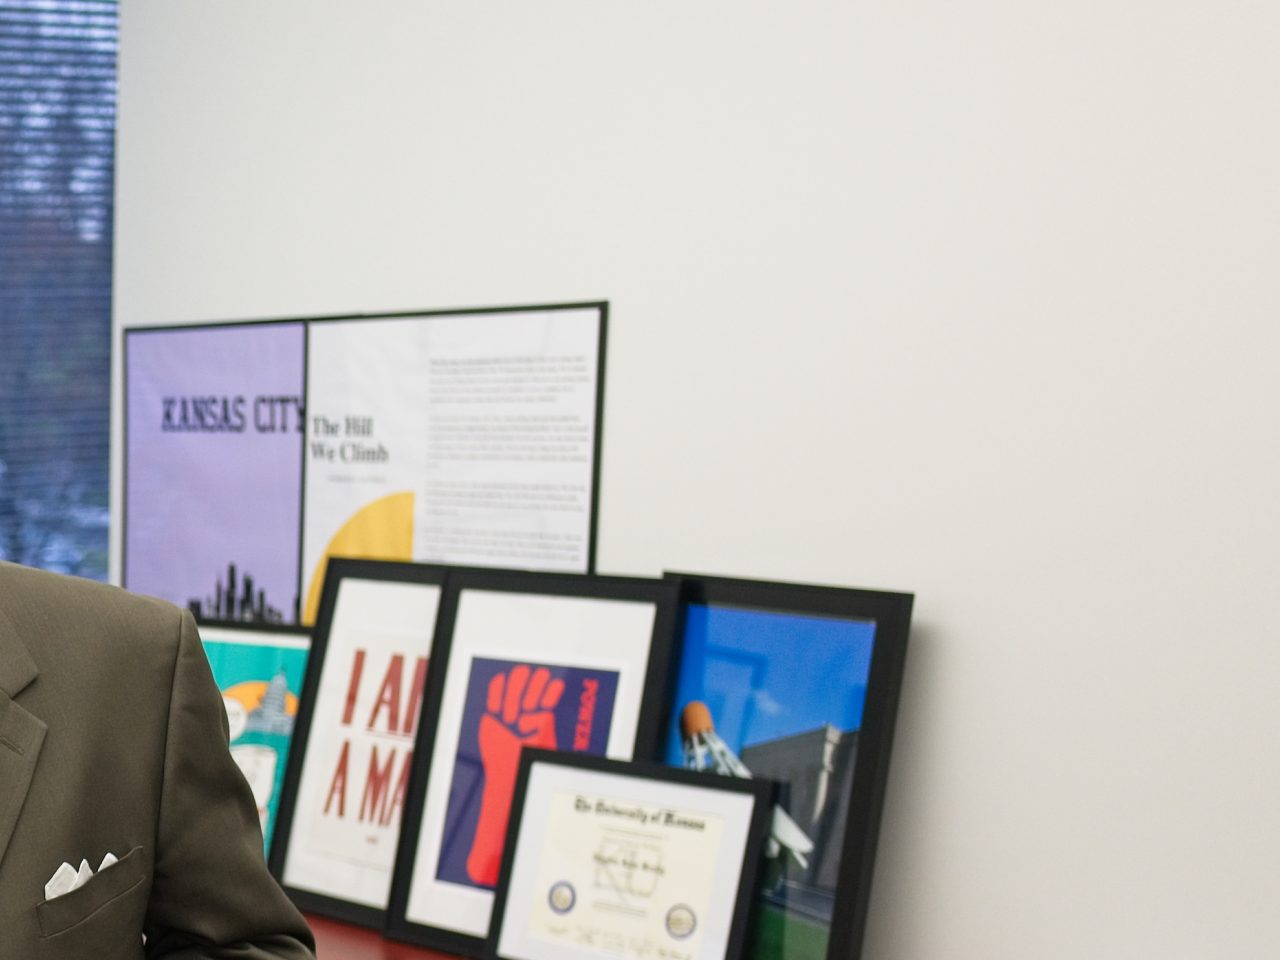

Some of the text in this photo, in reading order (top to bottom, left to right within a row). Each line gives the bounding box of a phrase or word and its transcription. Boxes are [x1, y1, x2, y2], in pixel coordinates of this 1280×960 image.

[161, 395, 306, 433] KANSAS CITY
[311, 415, 374, 438] The Hill
[310, 442, 389, 464] We Climb
[341, 649, 366, 726] I
[323, 739, 413, 827] A MA
[574, 794, 592, 812] The
[595, 798, 647, 826] University
